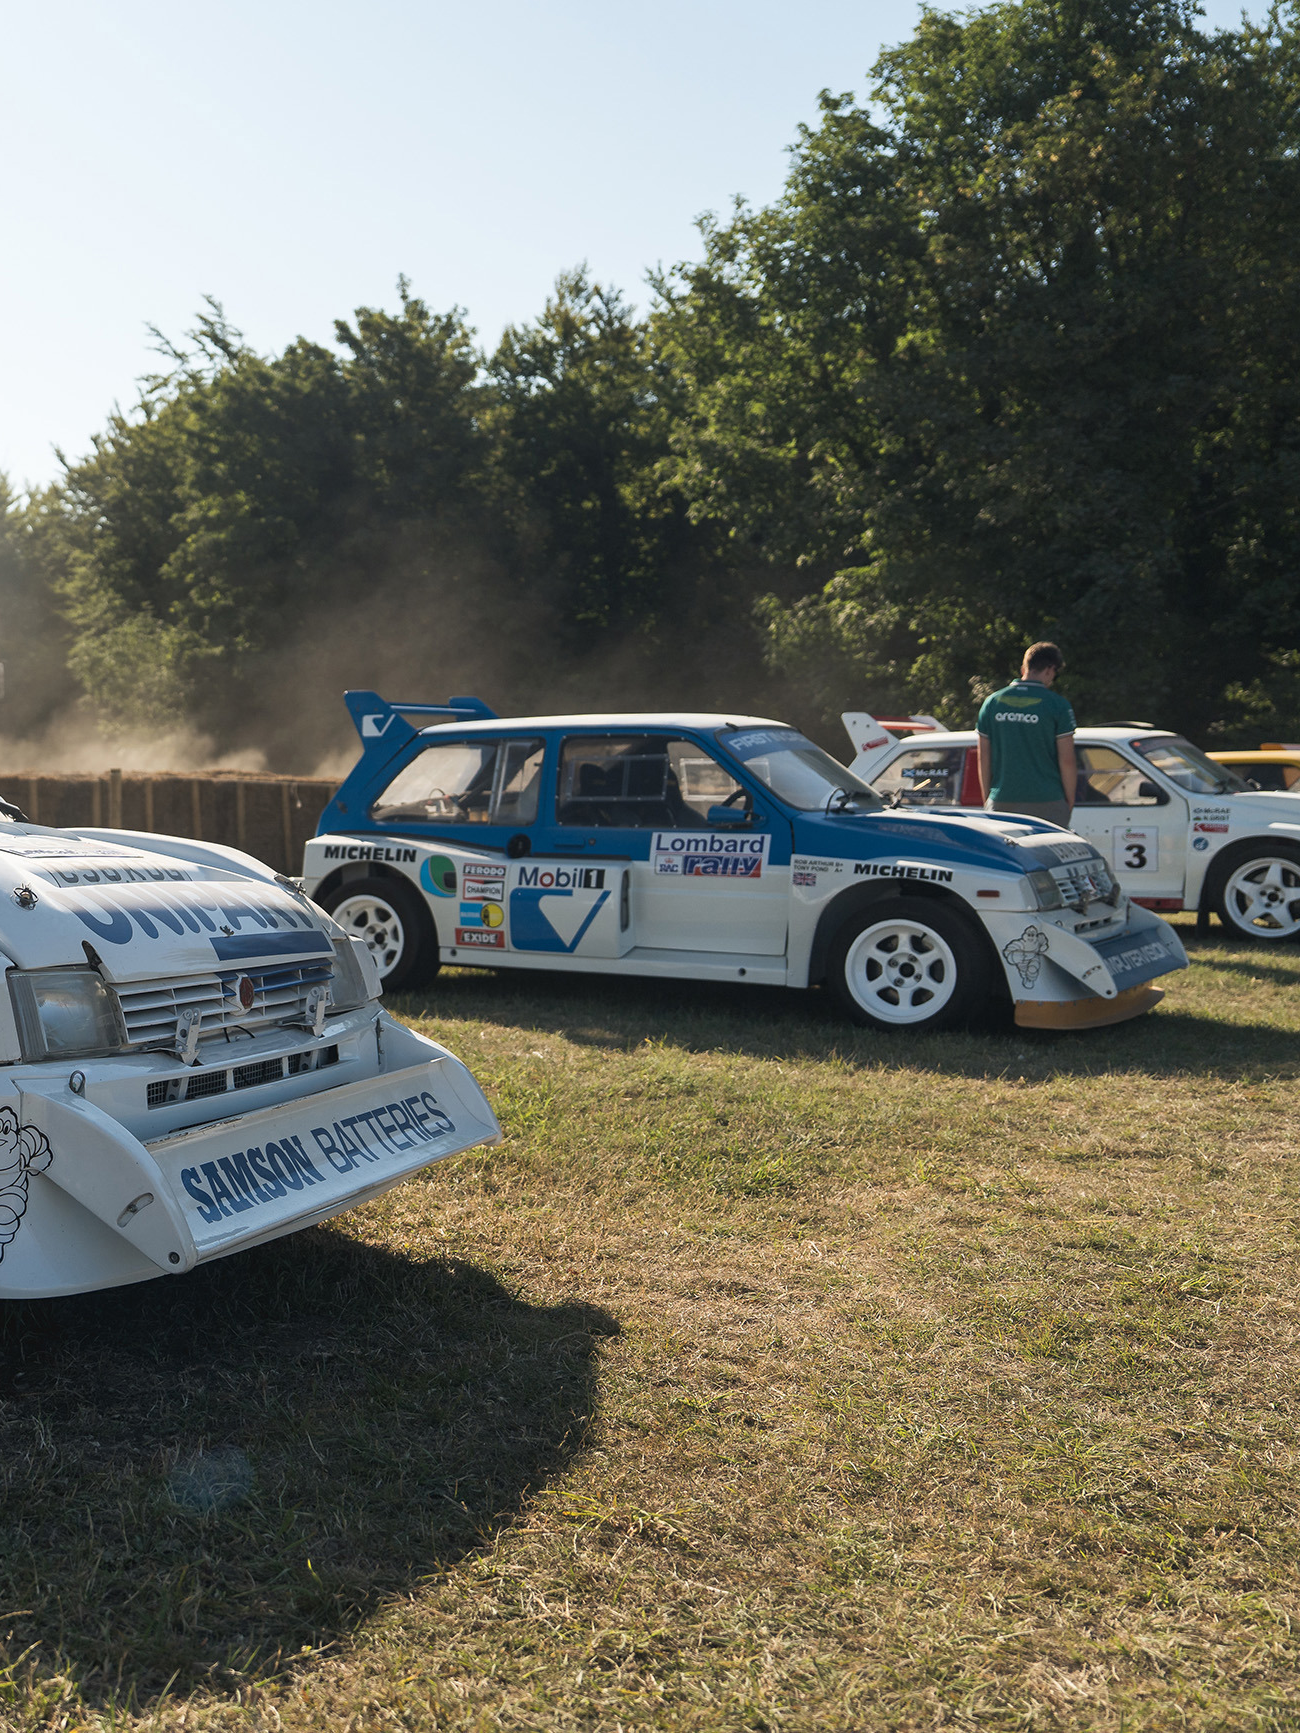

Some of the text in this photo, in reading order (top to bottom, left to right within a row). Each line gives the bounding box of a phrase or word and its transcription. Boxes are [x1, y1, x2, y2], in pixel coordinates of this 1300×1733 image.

[994, 712, 1039, 724] aramco
[728, 732, 773, 751] FIRST
[655, 833, 765, 853] Lombard
[324, 845, 417, 863] MICHELIN
[1124, 843, 1148, 869] 3
[464, 865, 505, 876] FERODO
[659, 854, 762, 877] RAC rally
[854, 863, 954, 882] MICHELIN
[518, 866, 583, 888] Mobil
[466, 885, 501, 895] CHAMPION
[463, 932, 497, 944] EXIDE
[180, 1091, 457, 1224] SAMSON BATTERIES
